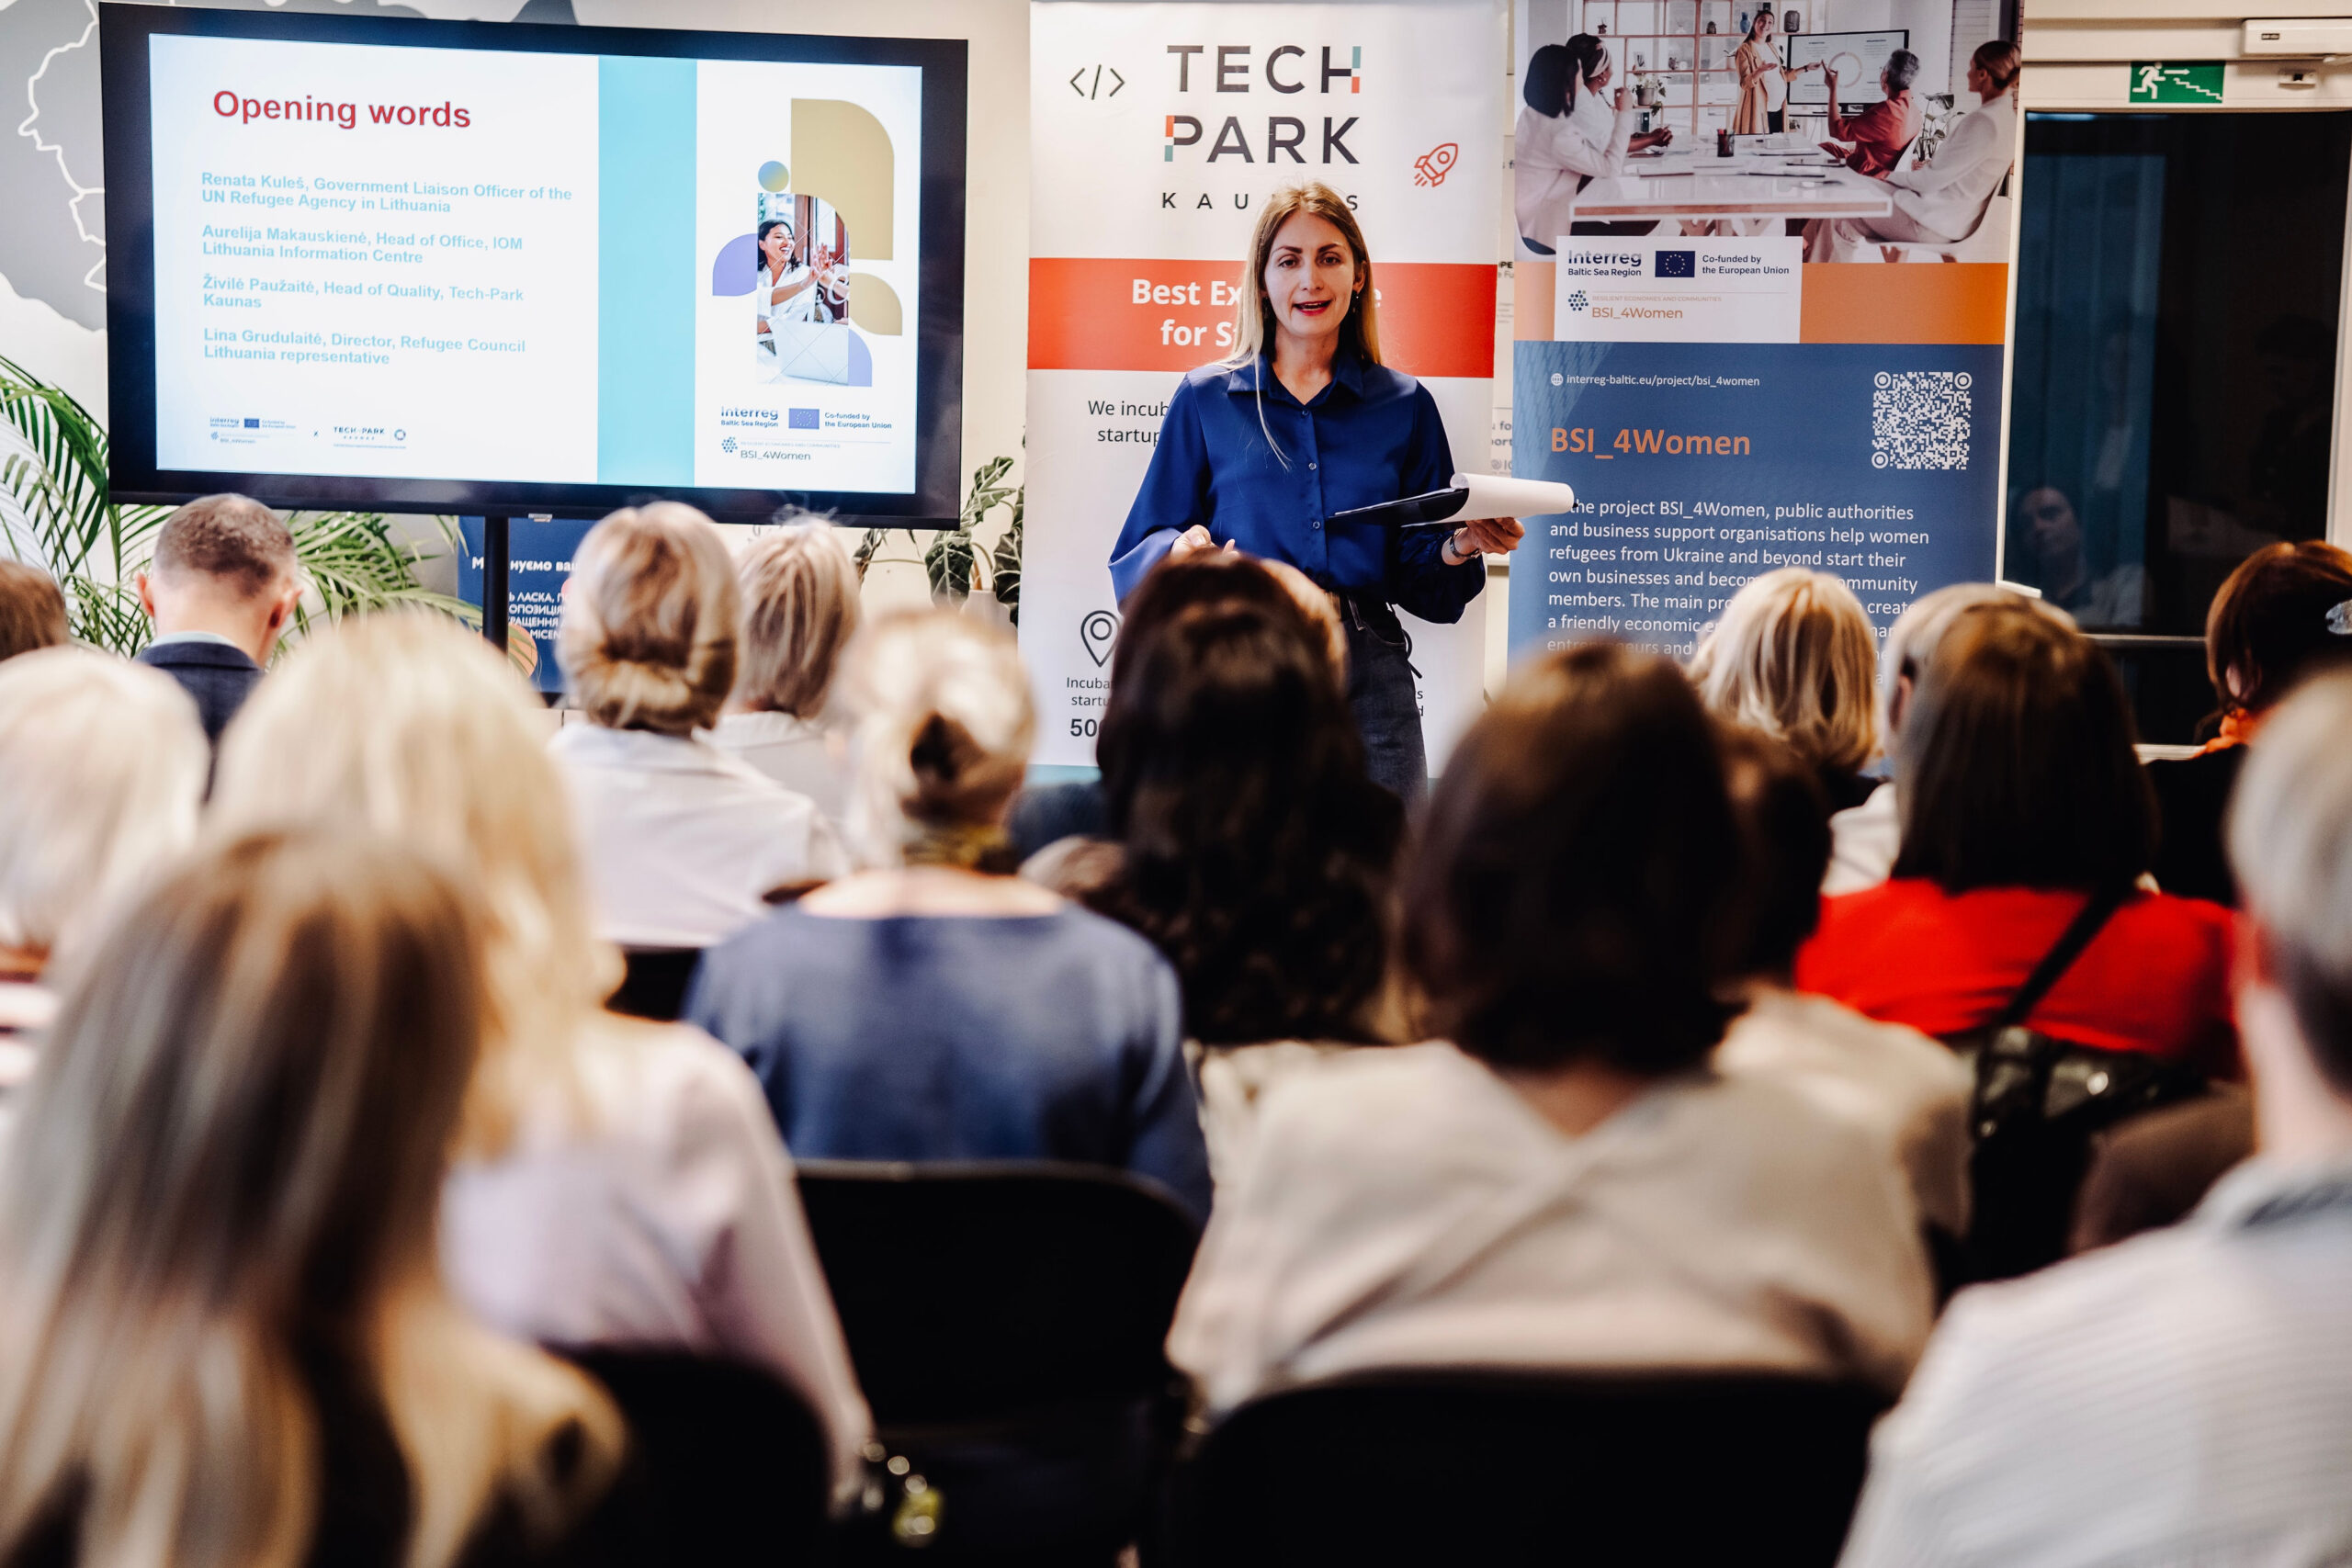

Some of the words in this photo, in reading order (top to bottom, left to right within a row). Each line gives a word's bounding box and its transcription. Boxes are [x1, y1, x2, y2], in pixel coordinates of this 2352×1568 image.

[1167, 45, 1362, 94] TECH
[213, 90, 356, 130] Opening
[368, 101, 471, 128] words
[1164, 115, 1360, 164] PARK
[201, 172, 256, 187] Renata
[261, 173, 310, 192] Kuleš,
[313, 177, 409, 195] Government
[413, 180, 469, 197] Liaison
[473, 183, 526, 199] Officer
[529, 185, 545, 199] of
[548, 186, 572, 200] the
[201, 189, 225, 204] UN
[231, 191, 294, 209] Refugee
[298, 194, 356, 212] Agency
[361, 197, 375, 210] in
[379, 197, 451, 213] Lithuania
[1161, 192, 1359, 211] KAUS
[202, 224, 262, 244] Aurelija
[266, 227, 371, 246] Makauskienė,
[376, 231, 414, 247] Head
[419, 233, 435, 247] of
[439, 234, 488, 251] Office,
[492, 236, 523, 251] IOM
[202, 242, 275, 258] Lithuania
[279, 245, 368, 262] Information
[372, 249, 424, 264] Centre
[1568, 250, 1642, 266] Interreg
[1702, 254, 1748, 263] Co-funded
[1751, 255, 1761, 265] by
[1568, 267, 1592, 276] Baltic
[1611, 268, 1642, 277] Region
[1719, 266, 1761, 276] European
[202, 274, 245, 291] Živilė
[250, 276, 319, 296] Paužaitė,
[323, 279, 362, 295] Head
[367, 281, 383, 296] of
[386, 283, 444, 301] Quality,
[449, 286, 524, 301] Tech-Park
[1132, 278, 1200, 306] Best
[203, 293, 262, 309] Kaunas
[1592, 306, 1683, 320] BSI_4Women
[204, 327, 238, 343] Lina
[242, 329, 327, 348] Grudulaitė,
[331, 333, 396, 351] Director,
[400, 335, 463, 354] Refugee
[467, 337, 526, 353] Council
[1160, 319, 1207, 348] for
[204, 344, 276, 361] Lithuania
[280, 349, 390, 366] representative
[1566, 373, 1760, 388] interreg-baltic.eu/project/bsi_4women
[721, 406, 778, 421] Interreg
[824, 412, 861, 420] Co-funded
[862, 413, 870, 422] by
[1088, 400, 1114, 415] We
[1121, 400, 1170, 416] incub
[837, 422, 870, 430] European
[1499, 421, 1512, 431] fo
[1097, 428, 1160, 447] startup
[1551, 427, 1751, 459] BSI_4Women
[741, 450, 811, 460] BSI_4Women
[1600, 501, 1655, 517] project
[1659, 502, 1770, 520] BSI_4Women,
[1775, 502, 1823, 521] public
[1827, 504, 1914, 520] authorities
[1550, 523, 1578, 536] and
[1583, 523, 1649, 538] business
[1654, 525, 1715, 542] support
[1720, 526, 1826, 544] organisations
[1830, 527, 1865, 546] help
[1870, 532, 1929, 544] women
[1549, 545, 1616, 563] refugees
[1621, 547, 1658, 561] from
[1664, 547, 1724, 563] Ukraine
[1728, 549, 1758, 564] and
[1763, 549, 1822, 568] beyond
[1826, 552, 1863, 566] start
[1868, 552, 1906, 567] their
[1549, 571, 1581, 583] own
[1587, 569, 1670, 585] businesses
[1675, 571, 1703, 586] and
[1838, 577, 1918, 594] ommunity
[1548, 592, 1625, 607] members.
[1631, 593, 1659, 608] The
[1665, 595, 1702, 609] main
[1548, 617, 1556, 628] a
[1561, 615, 1620, 633] friendly
[1624, 618, 1701, 632] economic
[1663, 641, 1692, 655] and
[1067, 677, 1111, 689] Incuba
[1071, 695, 1109, 706] startu
